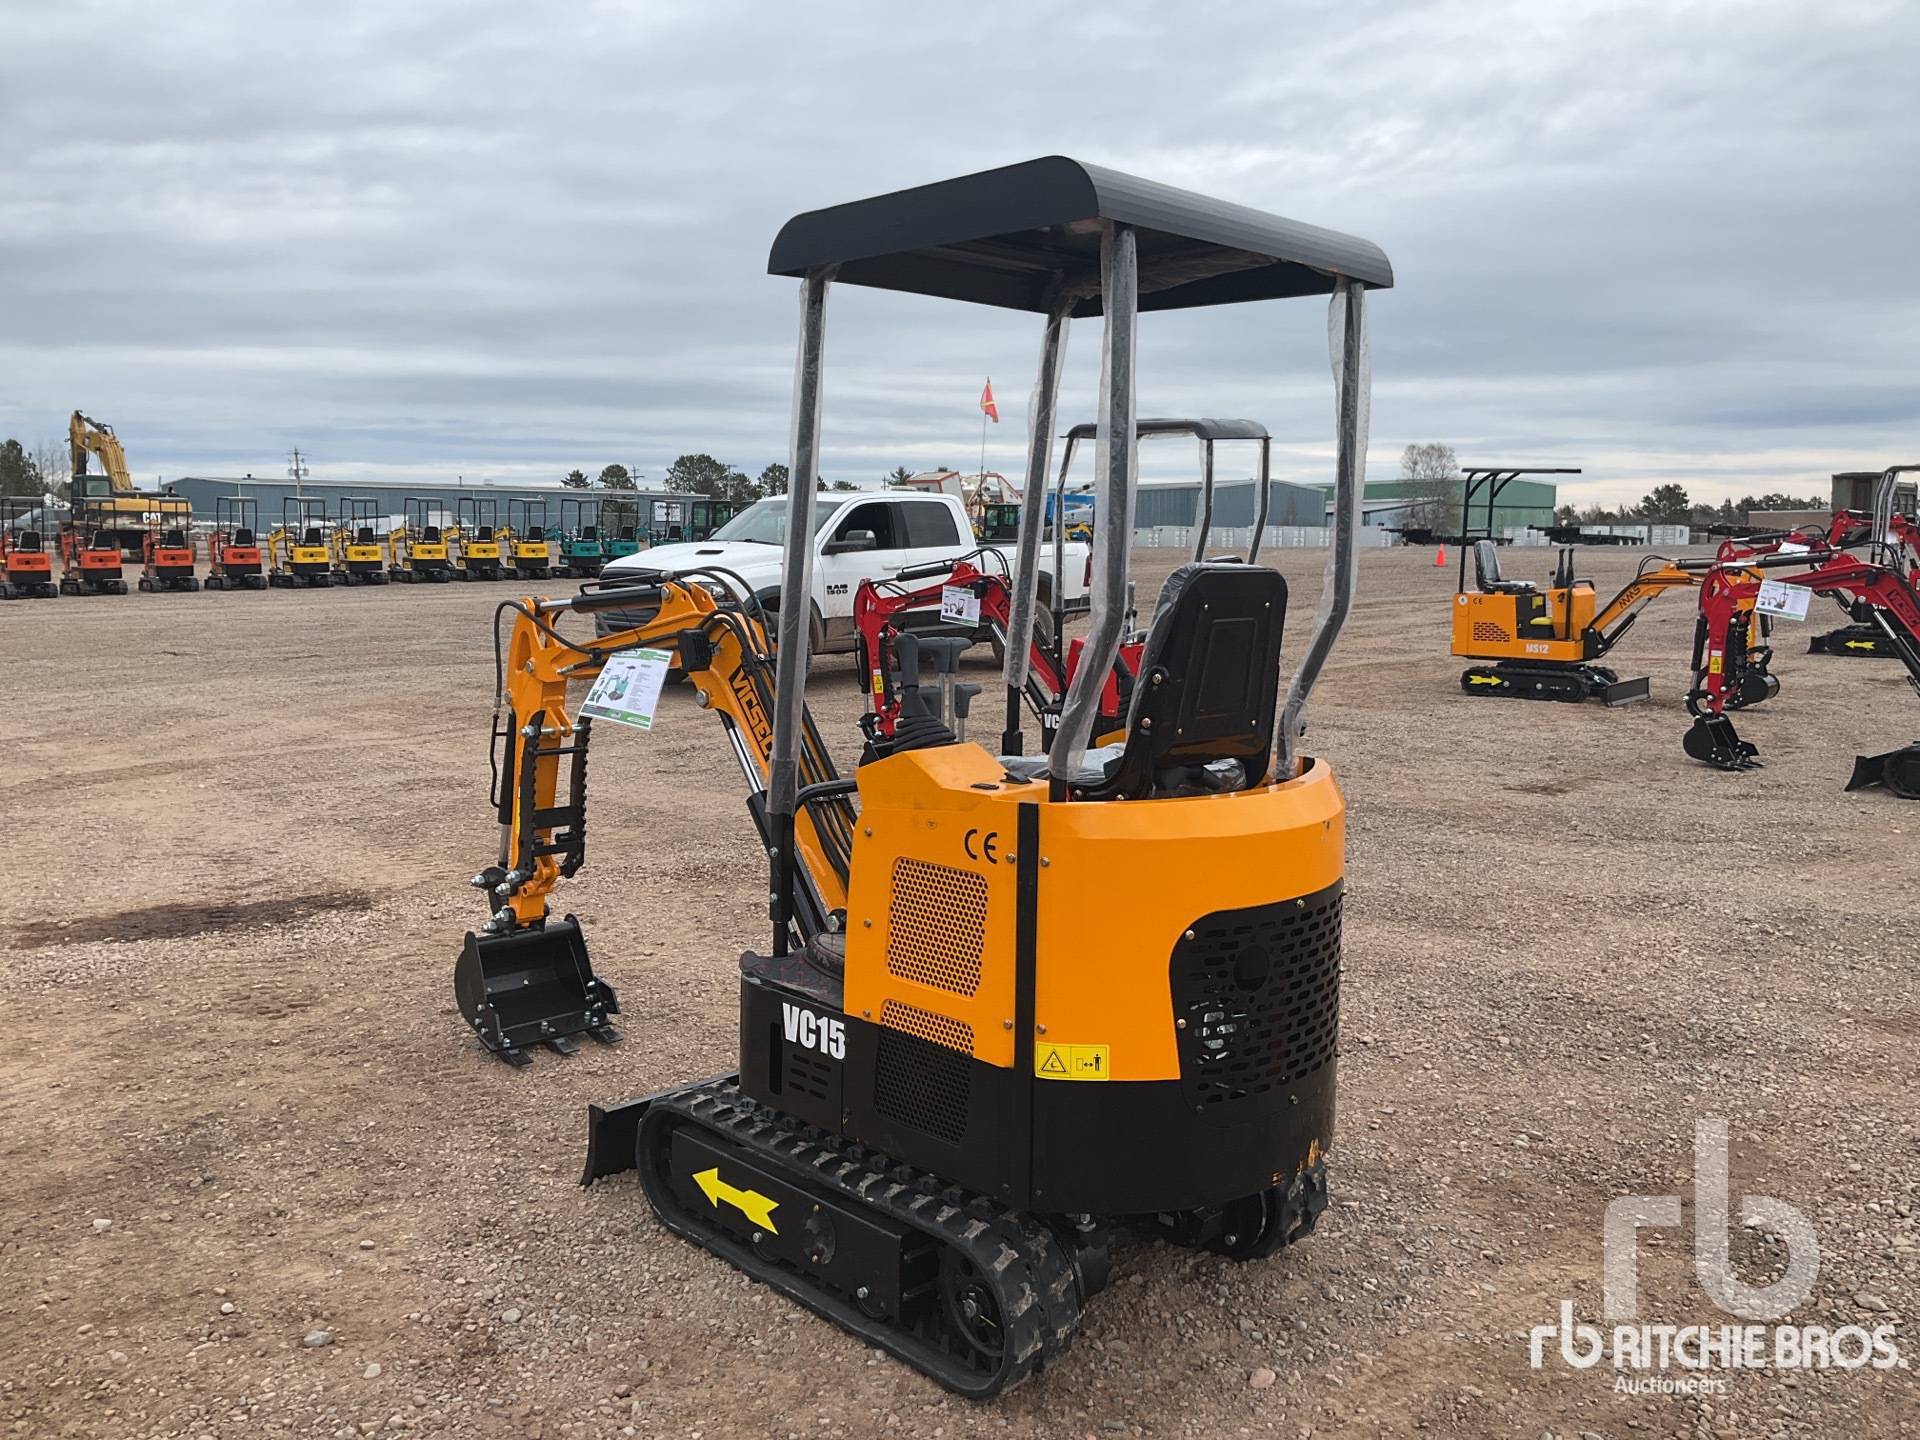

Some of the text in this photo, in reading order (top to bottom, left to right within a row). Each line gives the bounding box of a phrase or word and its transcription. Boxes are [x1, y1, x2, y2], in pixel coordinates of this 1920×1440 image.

[142, 511, 161, 524] CAT
[964, 828, 997, 864] CE
[782, 1002, 846, 1060] VC15
